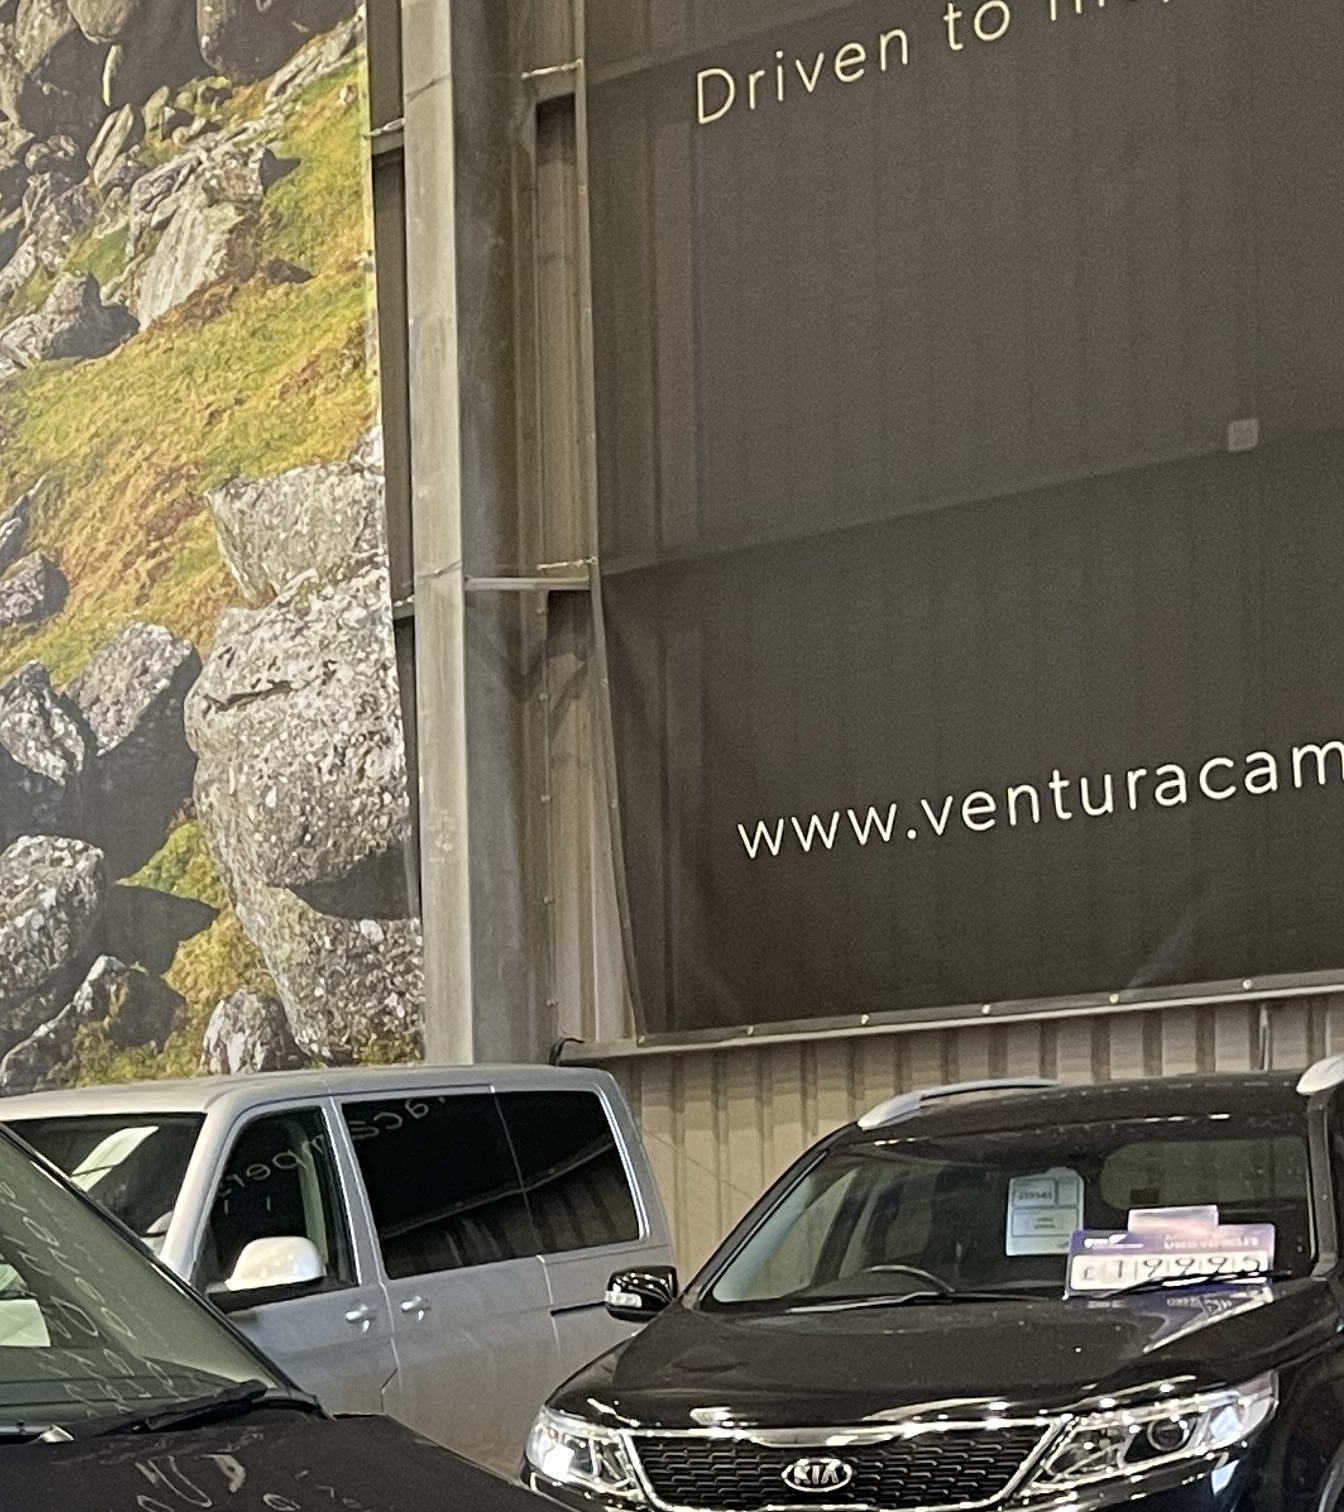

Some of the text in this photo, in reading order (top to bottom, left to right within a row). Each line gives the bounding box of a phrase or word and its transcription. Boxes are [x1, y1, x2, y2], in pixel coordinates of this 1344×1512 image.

[696, 1, 1011, 125] Driven to
[737, 737, 1344, 860] www.venturacam
[793, 1459, 840, 1485] KIA
